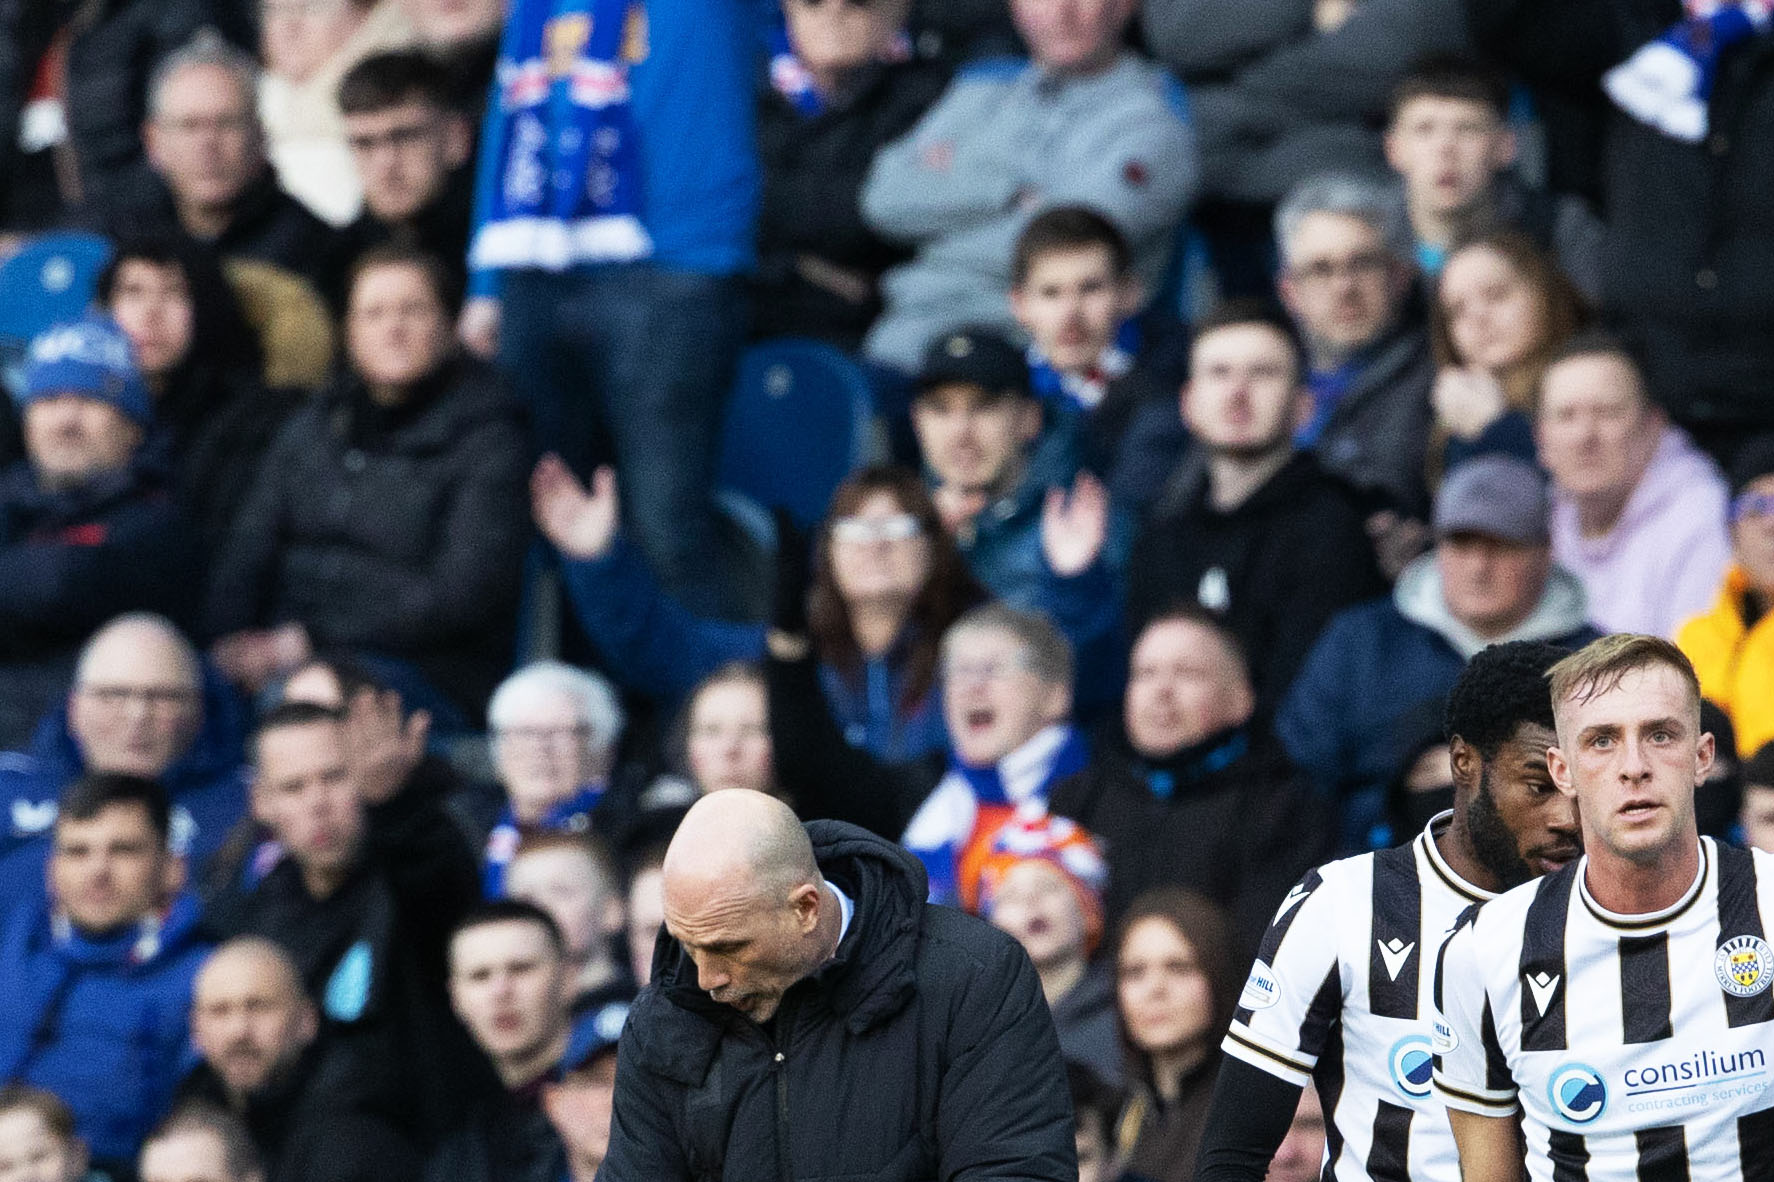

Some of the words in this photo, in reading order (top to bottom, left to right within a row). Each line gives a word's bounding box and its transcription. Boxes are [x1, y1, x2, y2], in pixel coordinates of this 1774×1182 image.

[1624, 1048, 1767, 1088] consilium
[1627, 1091, 1709, 1114] contracting
[1711, 1080, 1770, 1101] services
